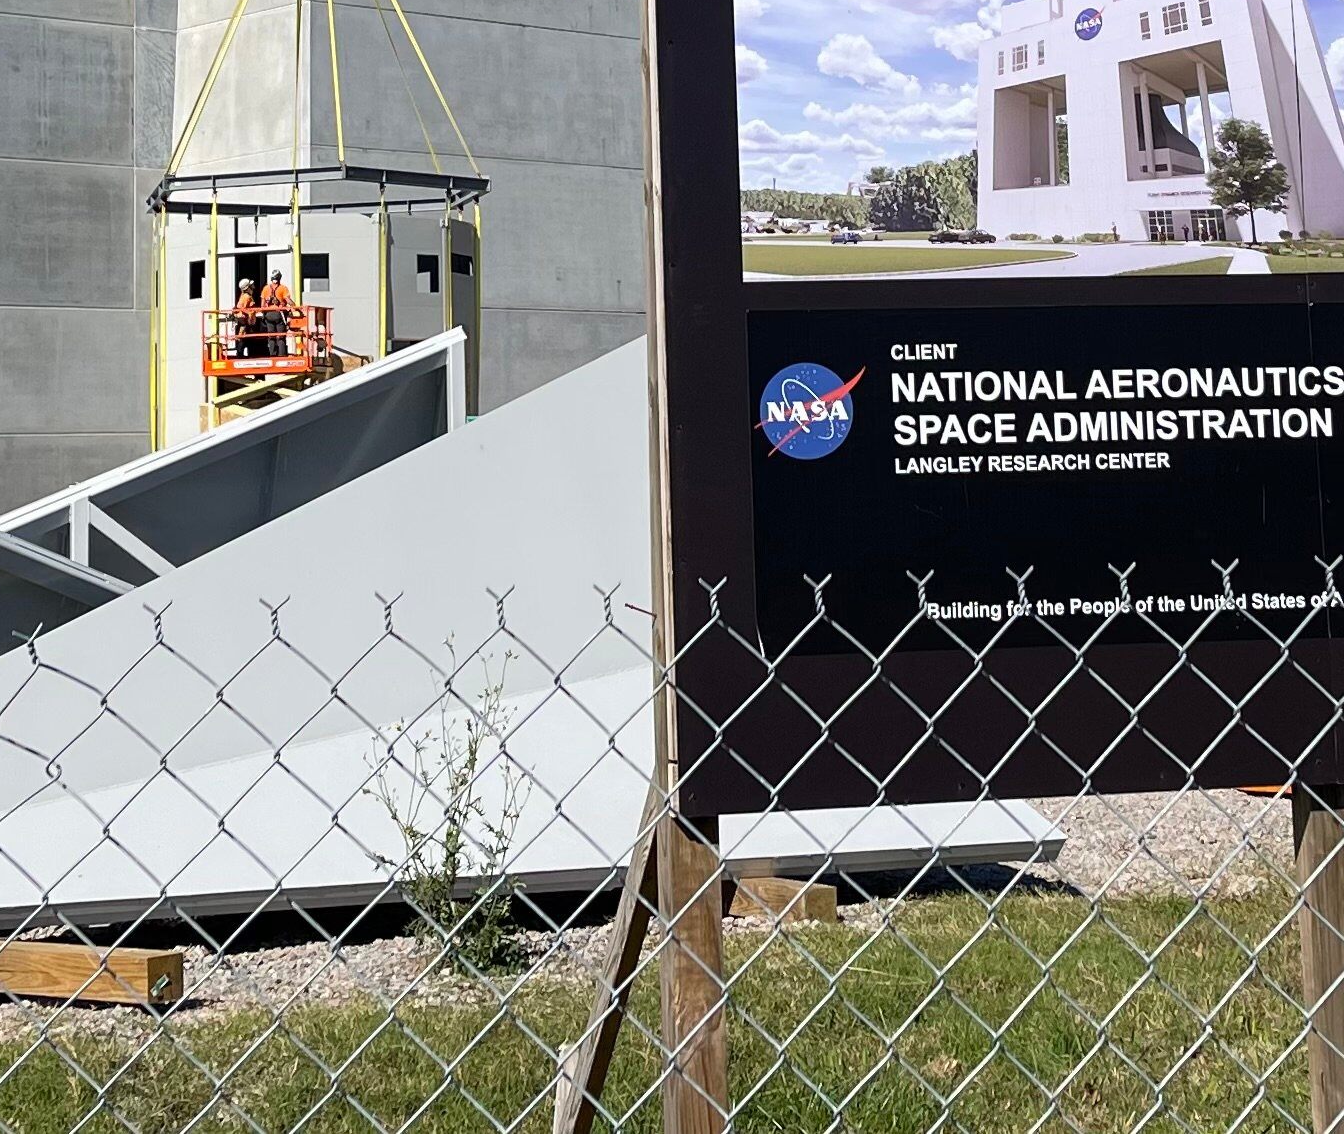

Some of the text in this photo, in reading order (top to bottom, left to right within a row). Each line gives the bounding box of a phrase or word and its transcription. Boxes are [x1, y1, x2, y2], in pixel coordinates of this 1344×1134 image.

[1076, 18, 1102, 32] NASA
[890, 343, 958, 361] CLIENT
[891, 370, 1078, 403] NATIONAL
[766, 399, 849, 422] NASA
[893, 407, 1333, 446] SPACE ADMINISTRATION
[894, 451, 1171, 475] LANGLEY RESEARCH CENTER
[927, 601, 1002, 622] Building
[1036, 599, 1065, 616] the
[1135, 596, 1154, 613] of
[1157, 595, 1185, 612] the
[1251, 592, 1306, 609] States
[1310, 591, 1328, 608] of
